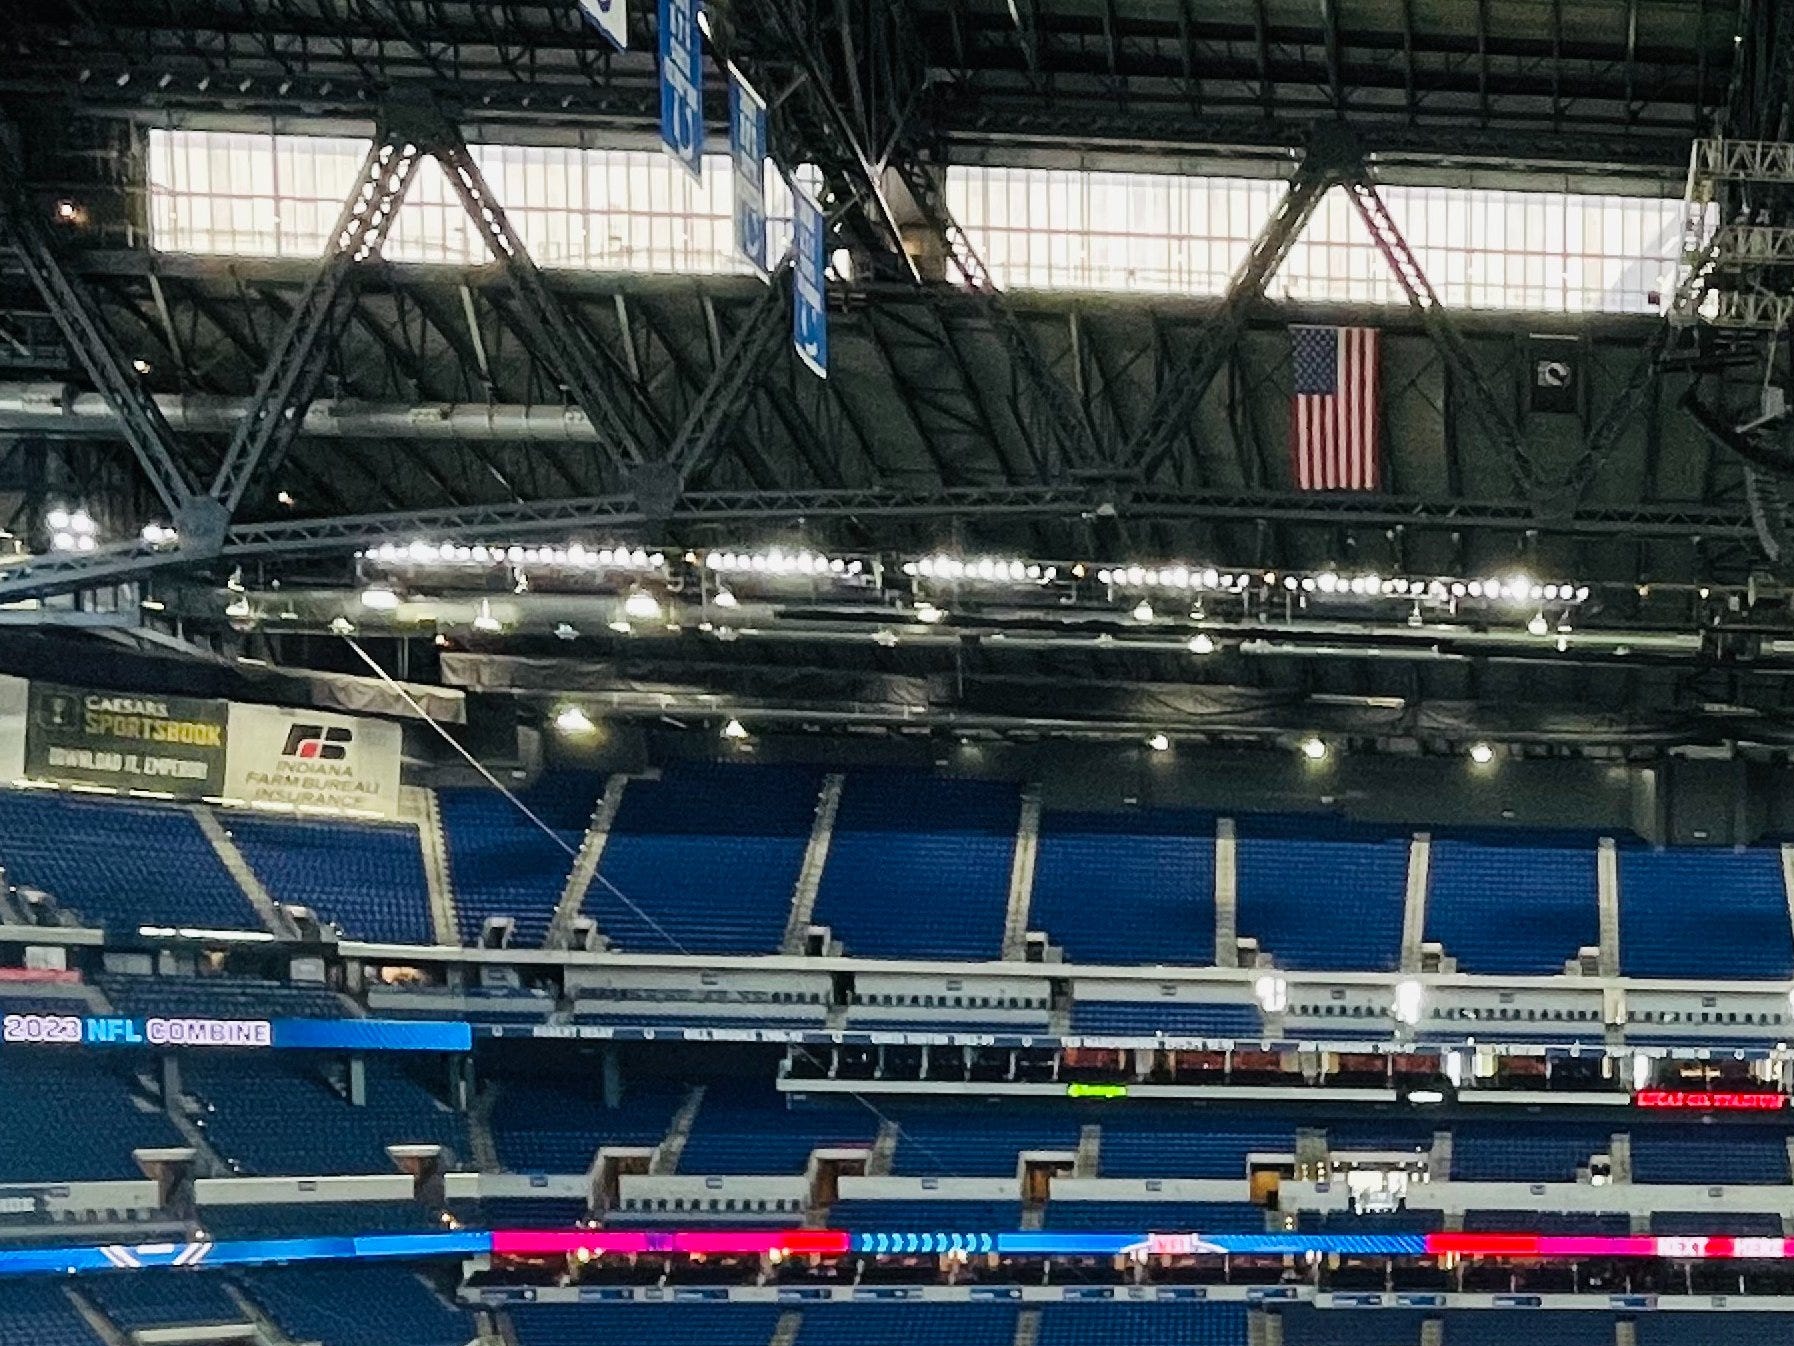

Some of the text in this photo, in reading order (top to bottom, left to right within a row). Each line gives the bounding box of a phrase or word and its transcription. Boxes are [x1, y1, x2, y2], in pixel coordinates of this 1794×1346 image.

[85, 695, 169, 717] CAESARS
[86, 711, 221, 747] SPORTSBOOK
[276, 760, 353, 777] INDIANA
[246, 771, 380, 795] FARM BUREAU
[3, 1015, 271, 1046] 2023 NFL COMBINE
